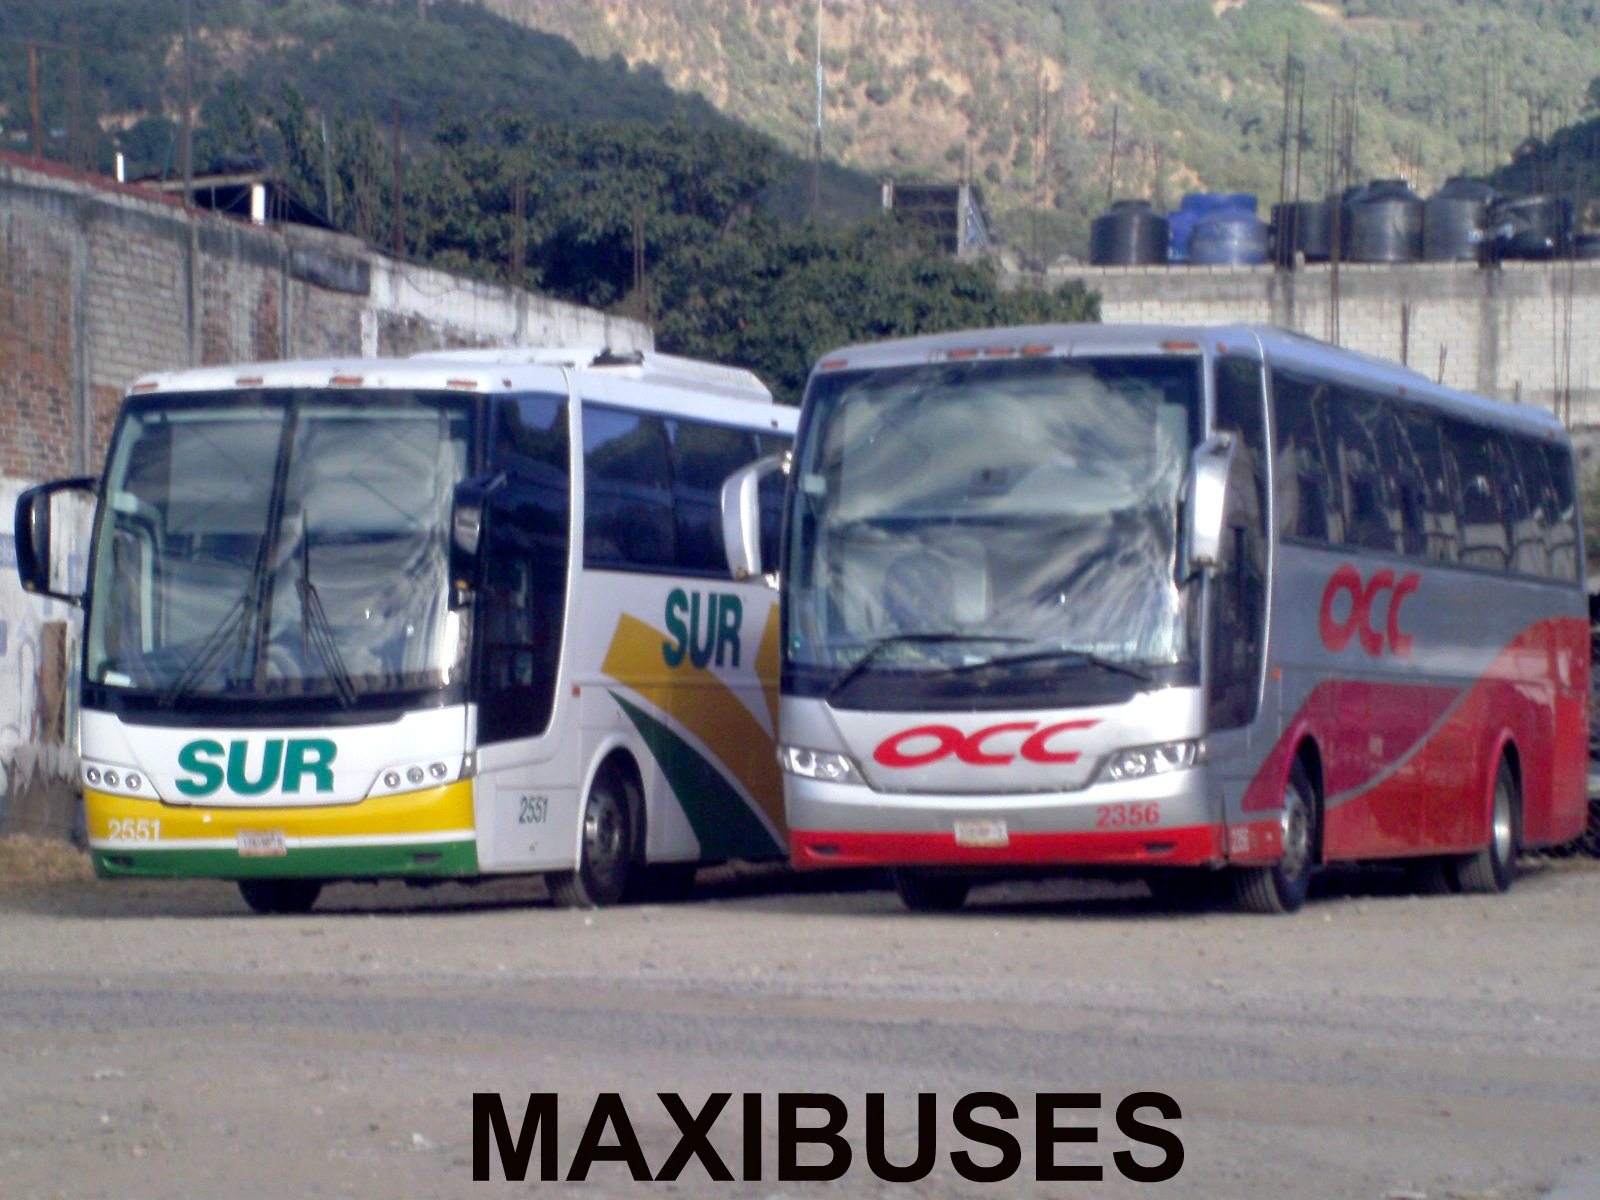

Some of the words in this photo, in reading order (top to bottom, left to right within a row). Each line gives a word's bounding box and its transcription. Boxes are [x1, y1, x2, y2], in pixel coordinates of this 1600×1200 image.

[661, 587, 743, 669] SUR
[174, 737, 338, 797] SUR
[518, 795, 549, 824] 2551
[1095, 801, 1161, 827] 2356
[107, 817, 161, 842] 2551
